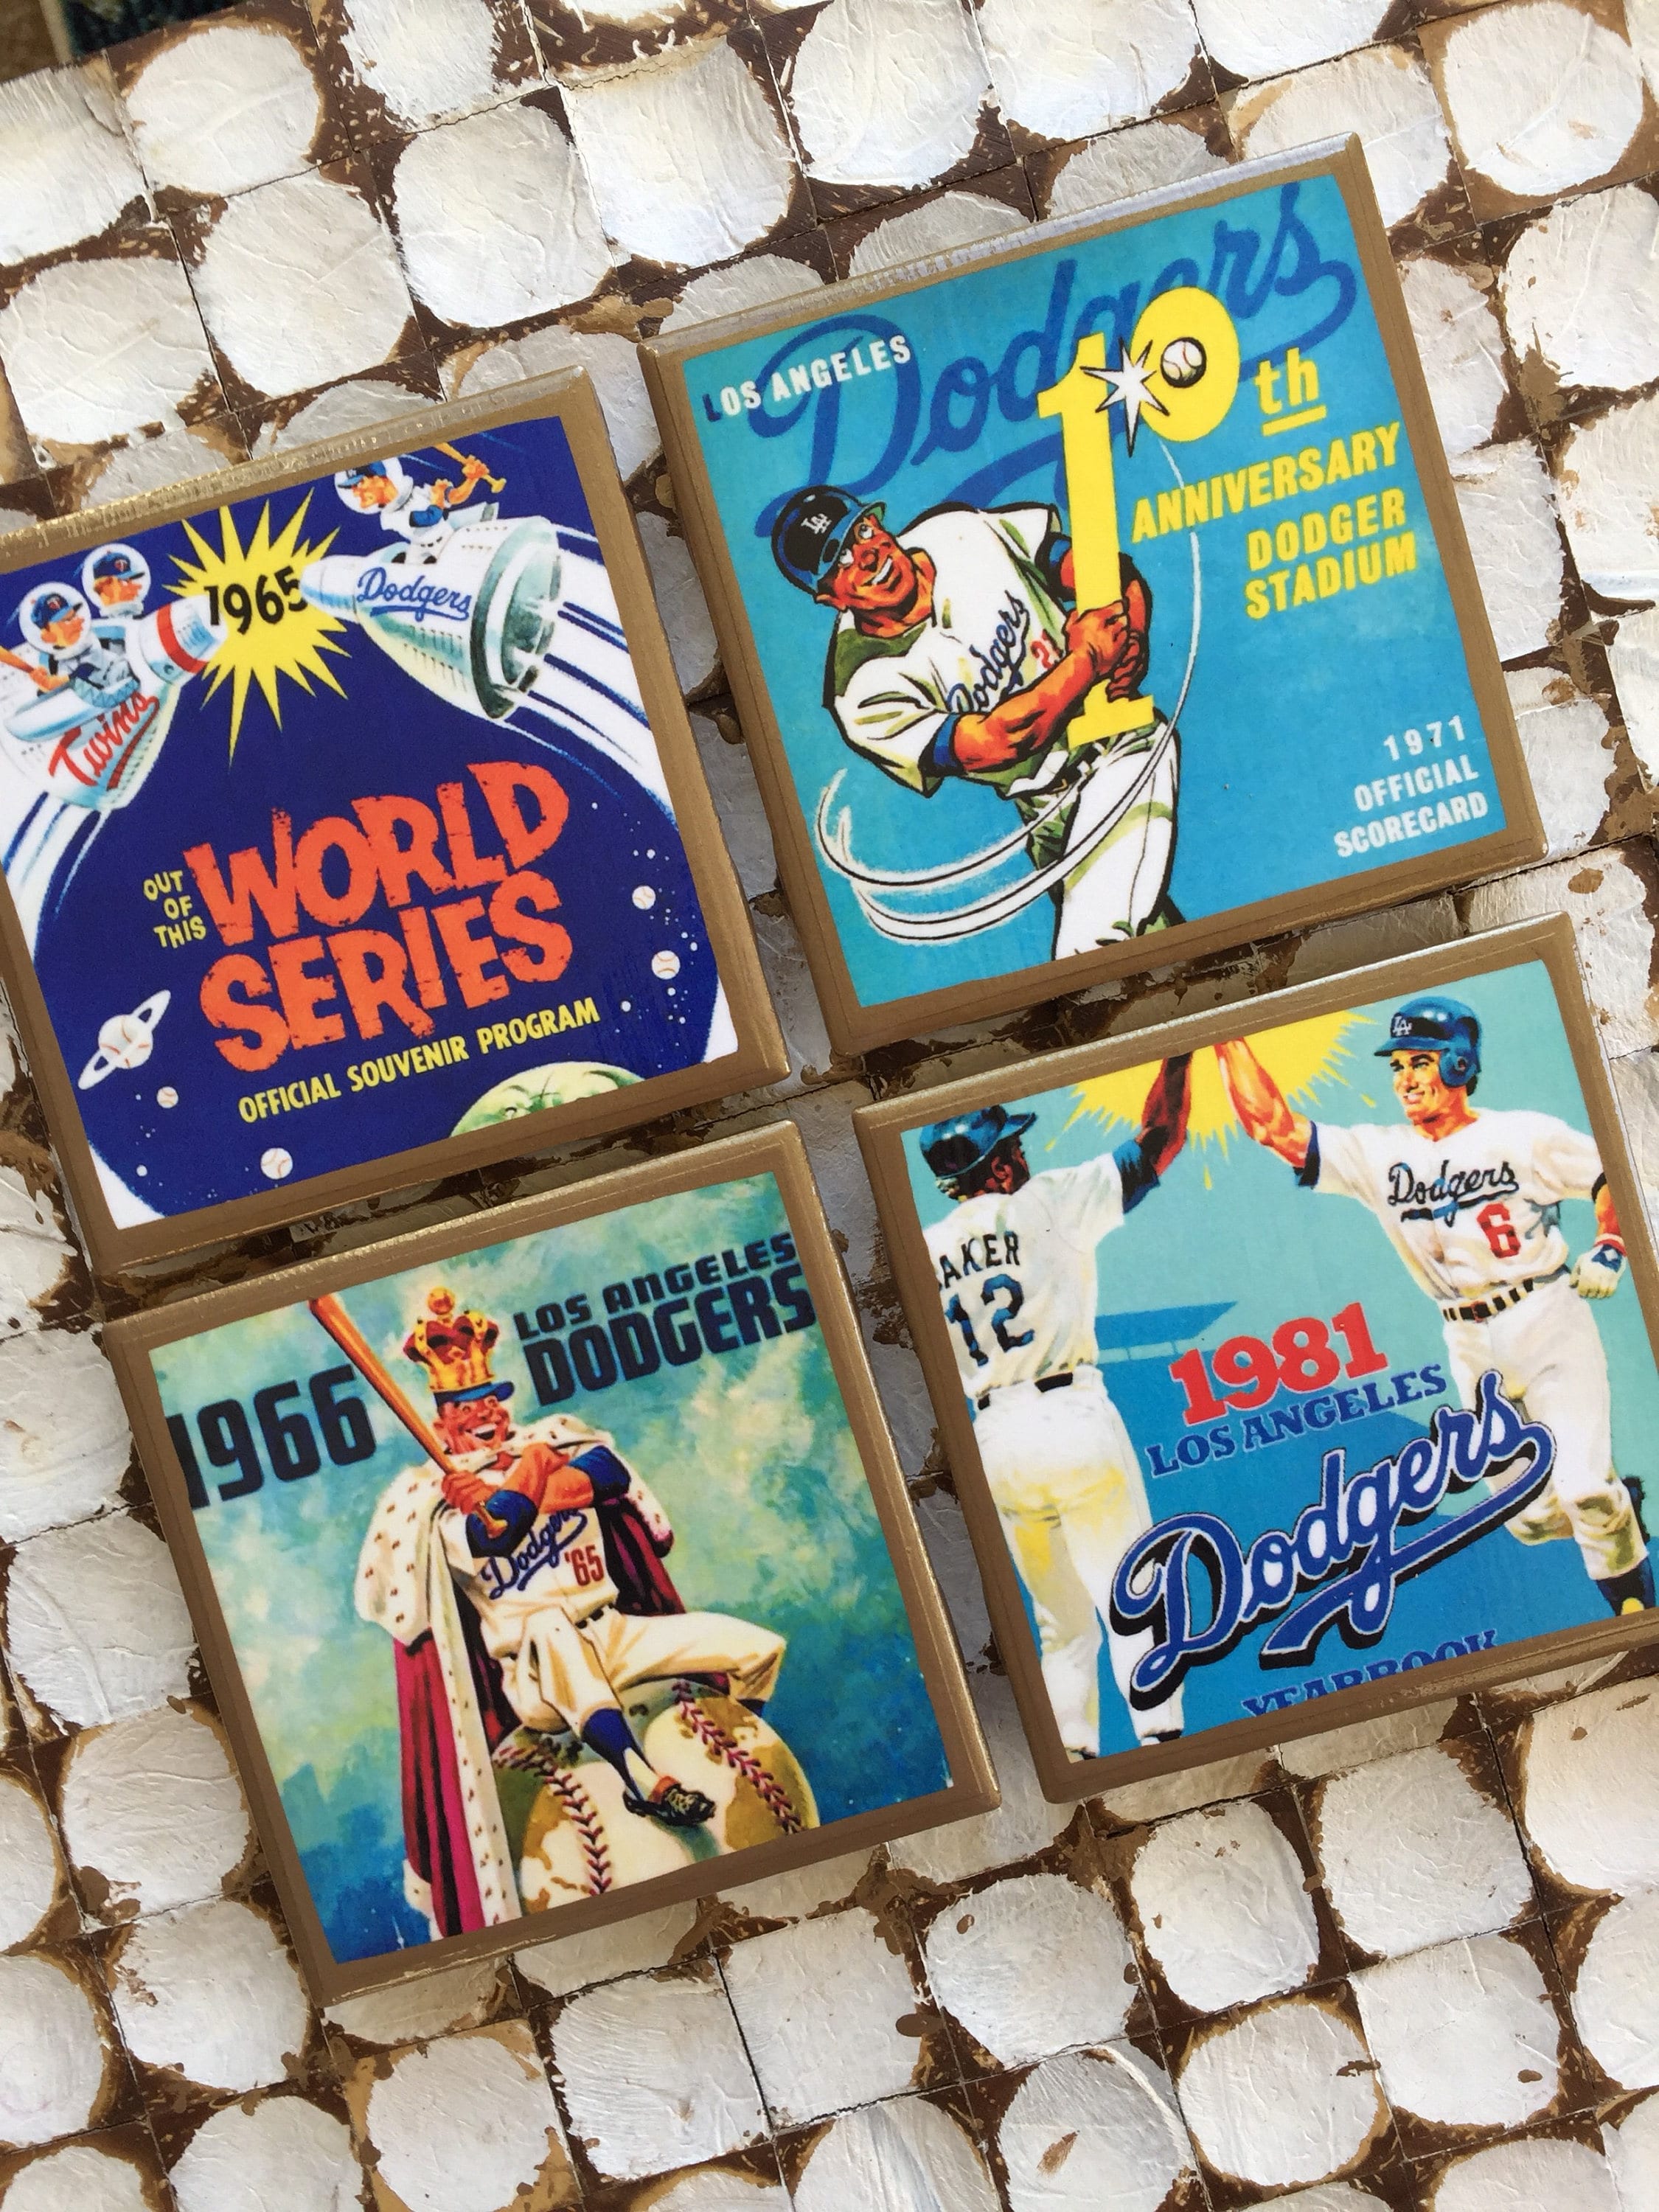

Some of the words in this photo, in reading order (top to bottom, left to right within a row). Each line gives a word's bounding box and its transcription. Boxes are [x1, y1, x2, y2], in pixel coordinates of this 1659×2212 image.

[703, 382, 761, 423] LOS
[771, 333, 912, 402] ANGELES
[1132, 422, 1400, 544] ANNIVERSARY
[1248, 488, 1405, 571] DODGER
[204, 566, 307, 635] 1965
[357, 567, 472, 620] Dodgers
[1245, 532, 1418, 620] STADIUM
[48, 691, 160, 791] Twins
[1383, 714, 1467, 762] 1971
[1334, 790, 1489, 858] SCORECARD
[1354, 762, 1479, 813] OFFICIAL
[143, 871, 184, 901] OUT
[183, 761, 569, 947] WORLD
[153, 916, 207, 949] THIS
[164, 898, 193, 919] OF
[200, 872, 572, 1072] SERIES
[238, 1069, 343, 1124] OFFICIAL
[347, 1034, 470, 1093] SOUVENIR
[478, 997, 600, 1048] PROGRAM
[1386, 1161, 1518, 1220] Dodgers
[1475, 1203, 1520, 1257] 6
[513, 1293, 592, 1340] LOS
[602, 1232, 798, 1314] ANGELES
[939, 1230, 1020, 1289] AKER
[524, 1264, 816, 1406] DODGERS
[945, 1274, 1034, 1366] 12
[1169, 1303, 1389, 1425] 1981
[166, 1364, 376, 1510] 1966
[1145, 1429, 1236, 1478] LOS
[1242, 1365, 1447, 1450] ANGELES
[565, 1545, 604, 1585] '65
[1110, 1368, 1557, 1710] Dodgers
